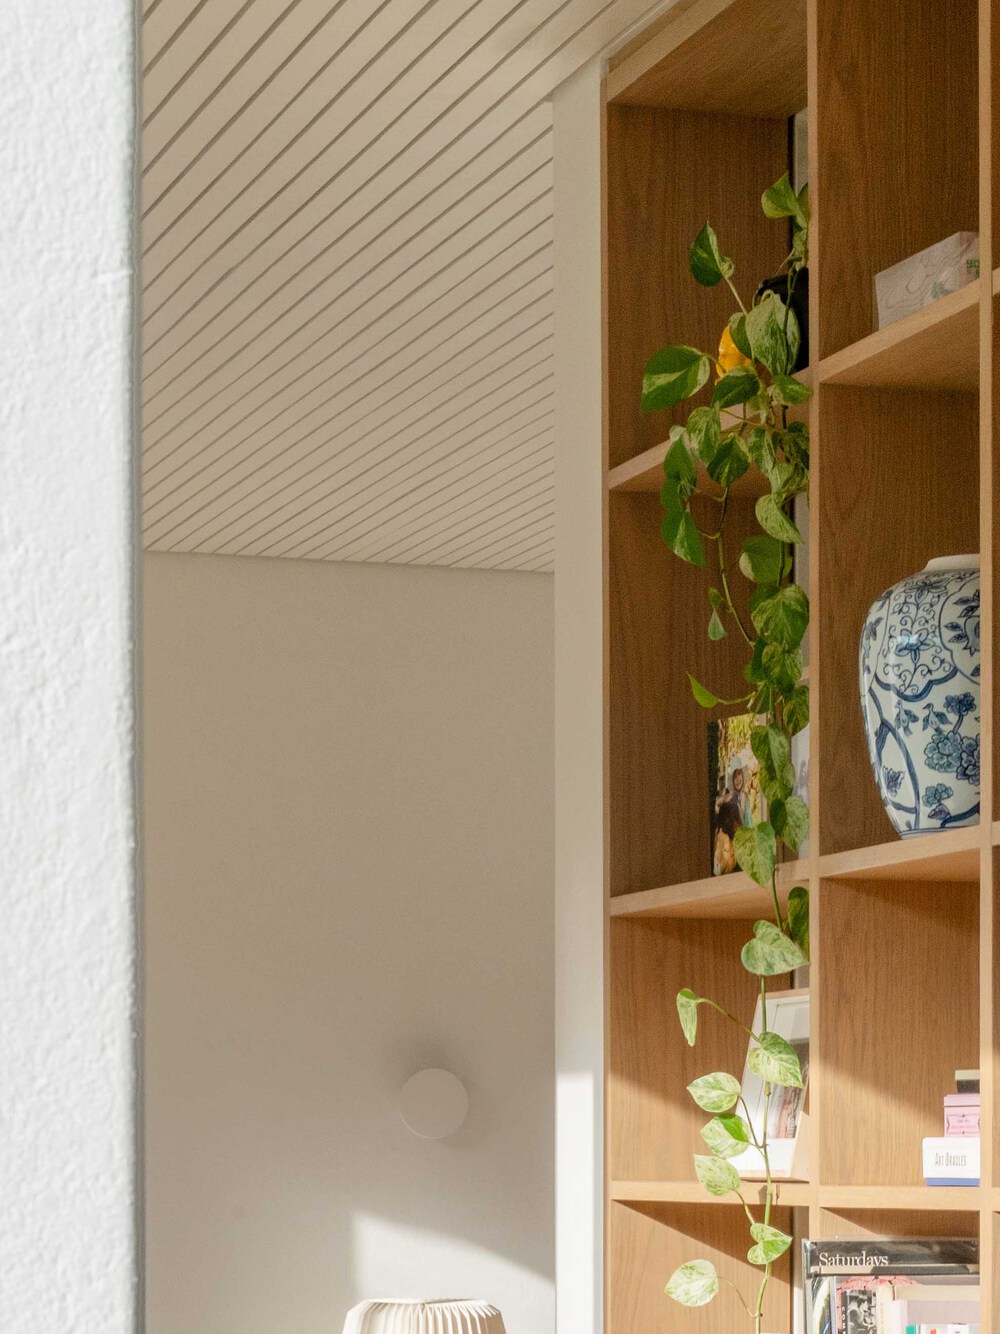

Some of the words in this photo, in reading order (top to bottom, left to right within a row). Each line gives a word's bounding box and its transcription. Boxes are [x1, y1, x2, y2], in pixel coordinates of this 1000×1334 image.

[935, 1153, 944, 1166] ART
[945, 1152, 967, 1166] ORACLES
[819, 1250, 889, 1267] Saturdays
